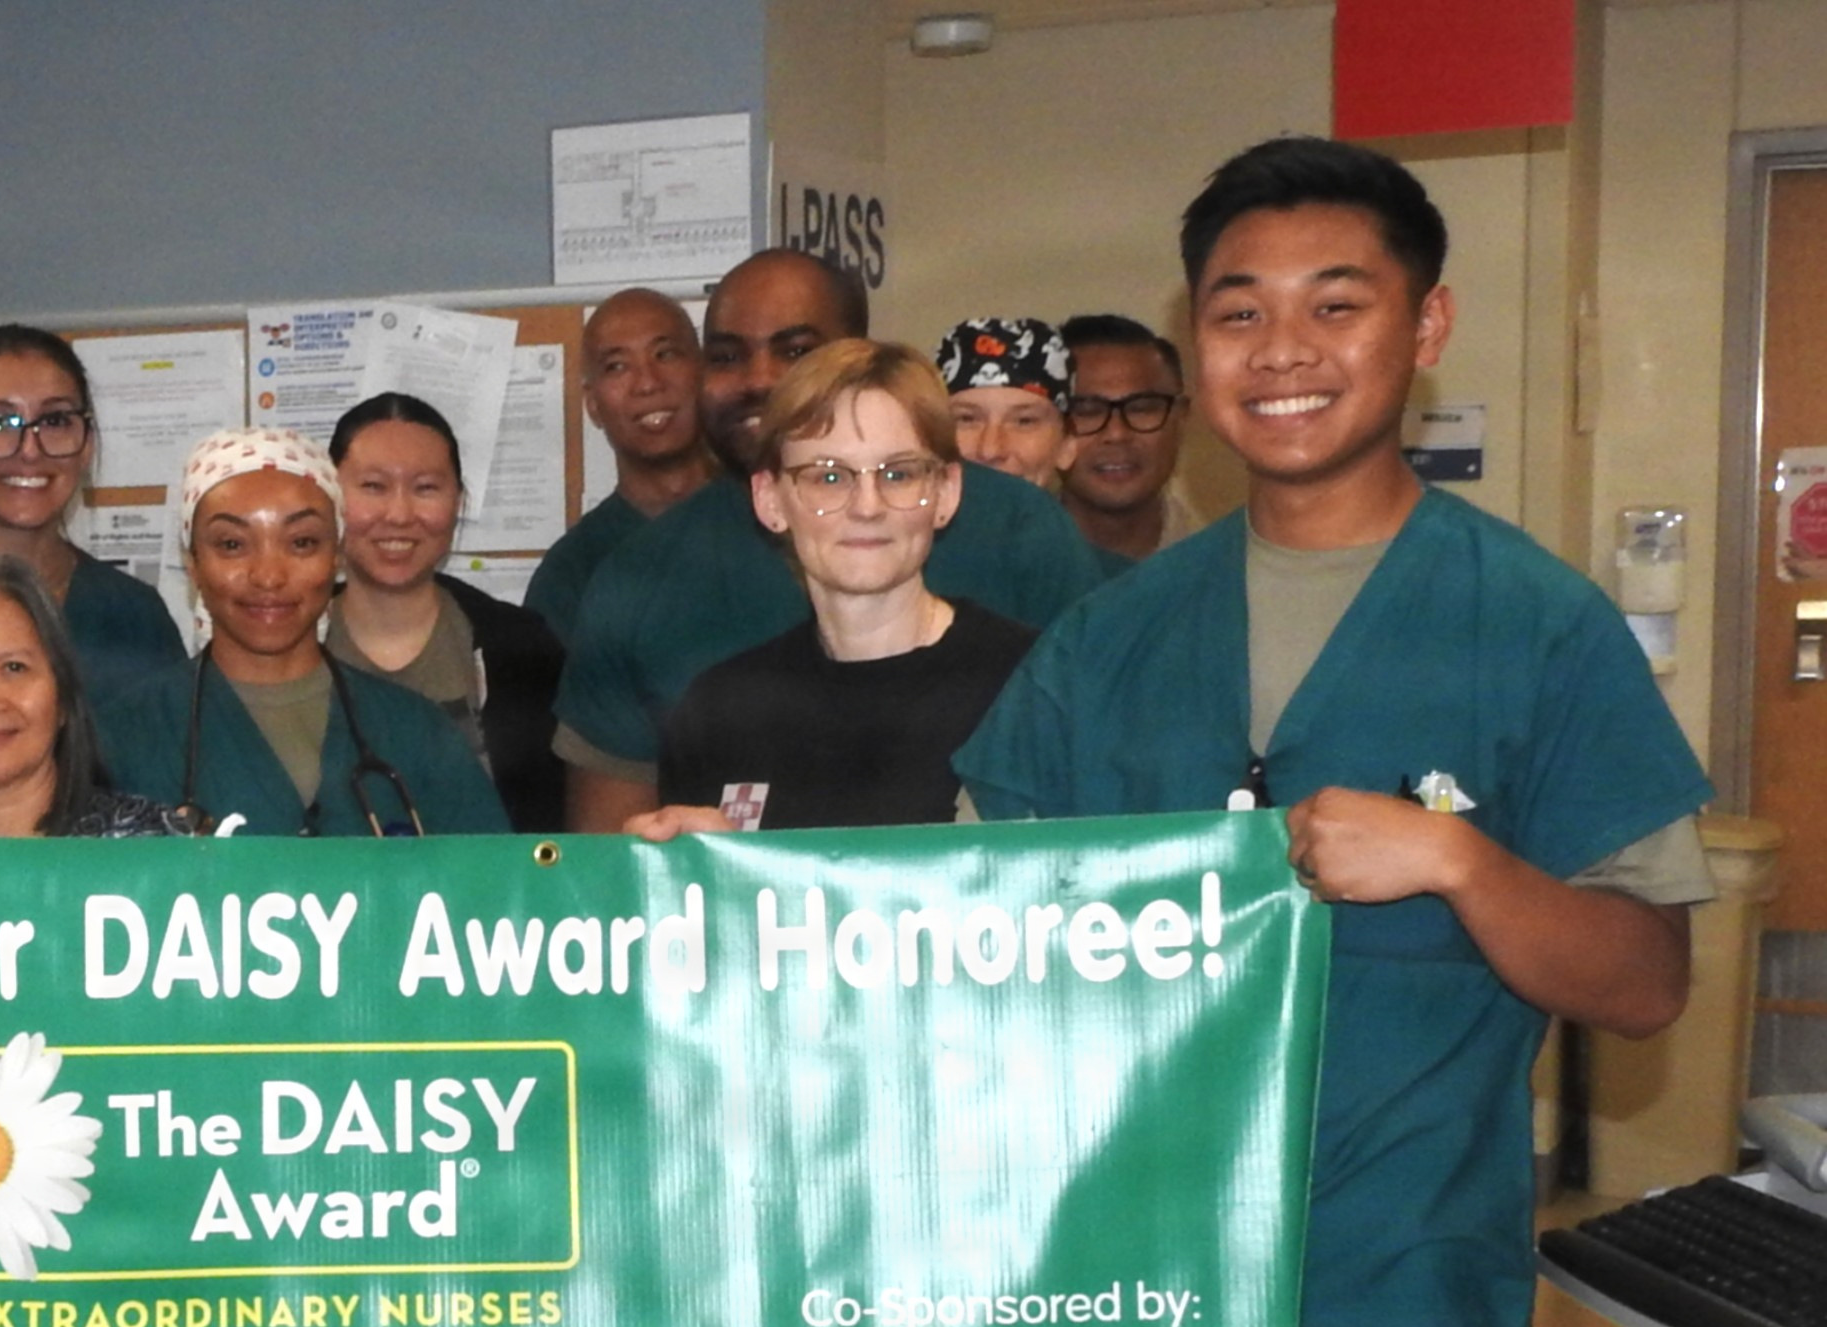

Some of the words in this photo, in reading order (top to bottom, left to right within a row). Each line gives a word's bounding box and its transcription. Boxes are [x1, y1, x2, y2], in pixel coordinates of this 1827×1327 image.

[84, 892, 358, 1000] DAISY
[399, 882, 707, 998] Award
[757, 871, 1225, 992] Honoree!
[108, 1090, 241, 1158] The
[262, 1078, 537, 1155] DAISY
[379, 1291, 563, 1327] NURSES
